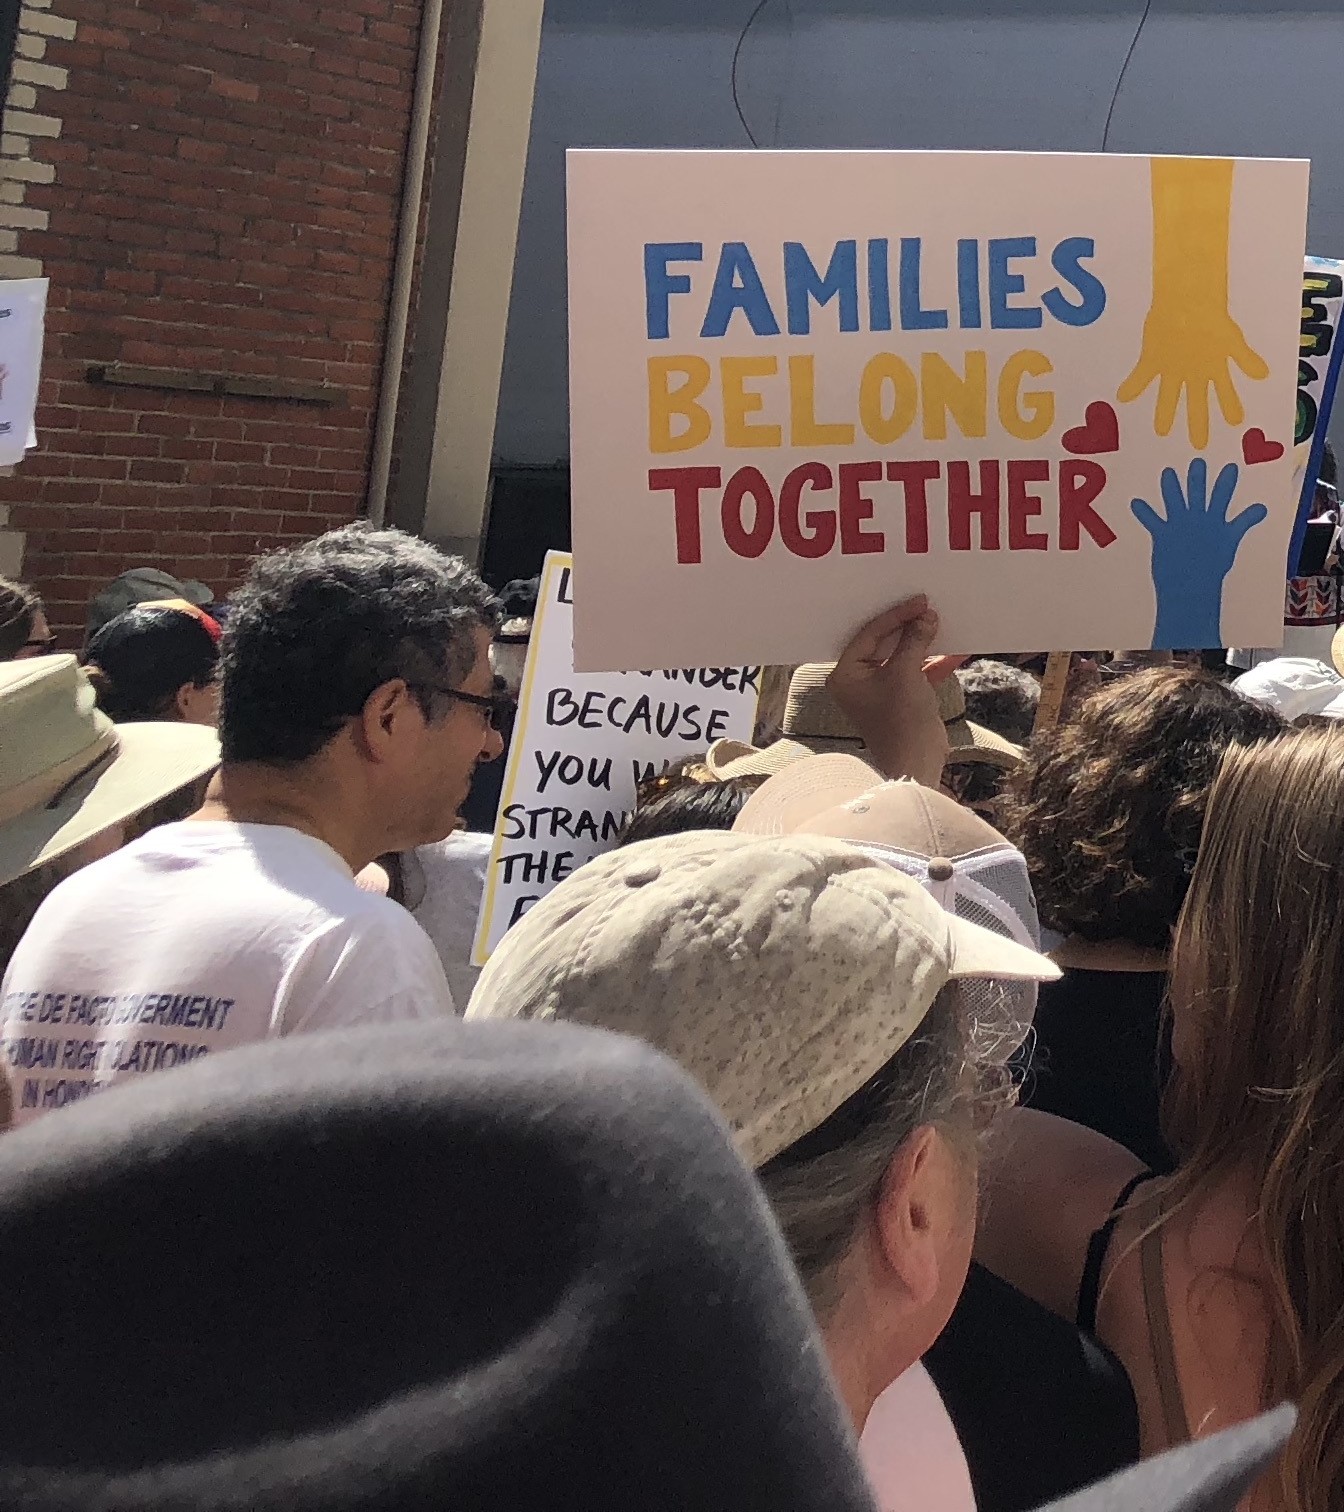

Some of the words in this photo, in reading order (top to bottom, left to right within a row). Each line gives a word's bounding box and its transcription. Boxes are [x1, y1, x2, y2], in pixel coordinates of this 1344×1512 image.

[643, 236, 1107, 340] FAMILIES
[647, 349, 1056, 454] BELONG
[648, 458, 1118, 565] TOGETHER
[547, 687, 730, 741] BECAUSE
[534, 750, 612, 793] YOU
